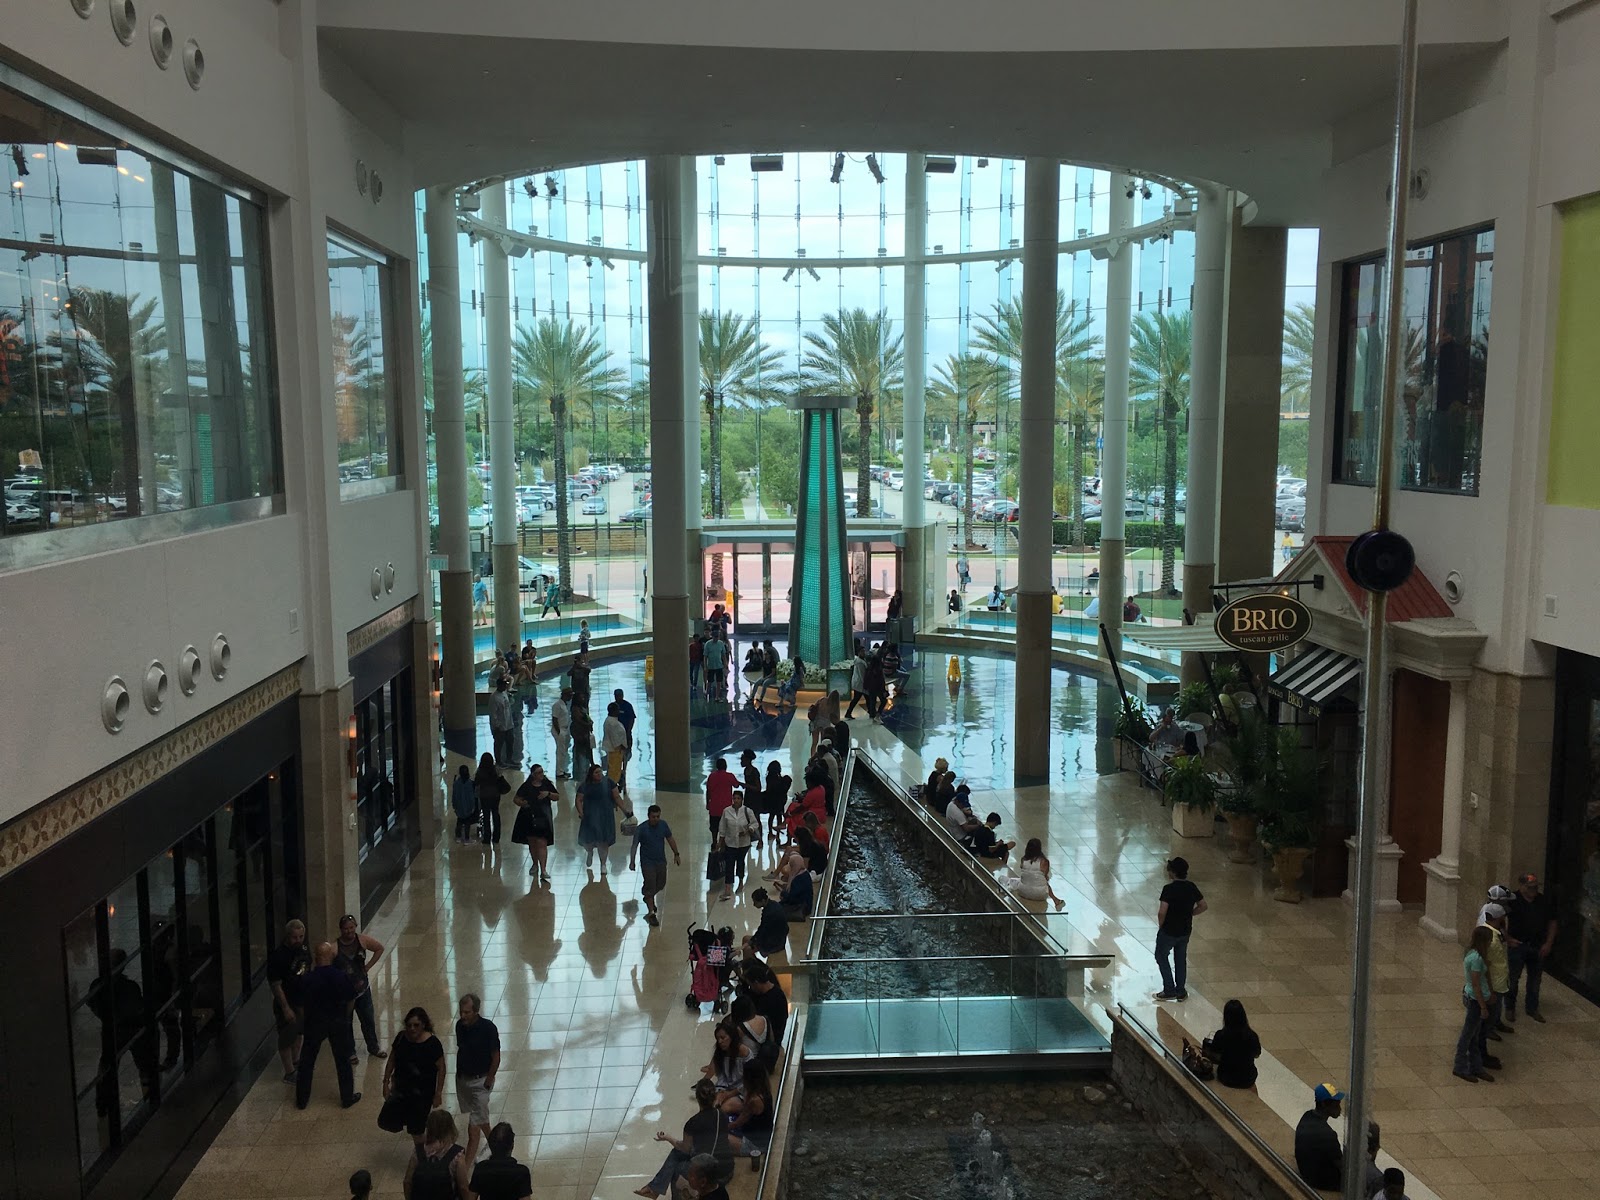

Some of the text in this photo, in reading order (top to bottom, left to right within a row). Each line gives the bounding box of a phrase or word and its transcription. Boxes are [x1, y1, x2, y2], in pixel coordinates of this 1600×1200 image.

[1231, 607, 1298, 632] BRIO
[1240, 633, 1289, 643] tuscan grille
[1287, 690, 1303, 708] BRIO
